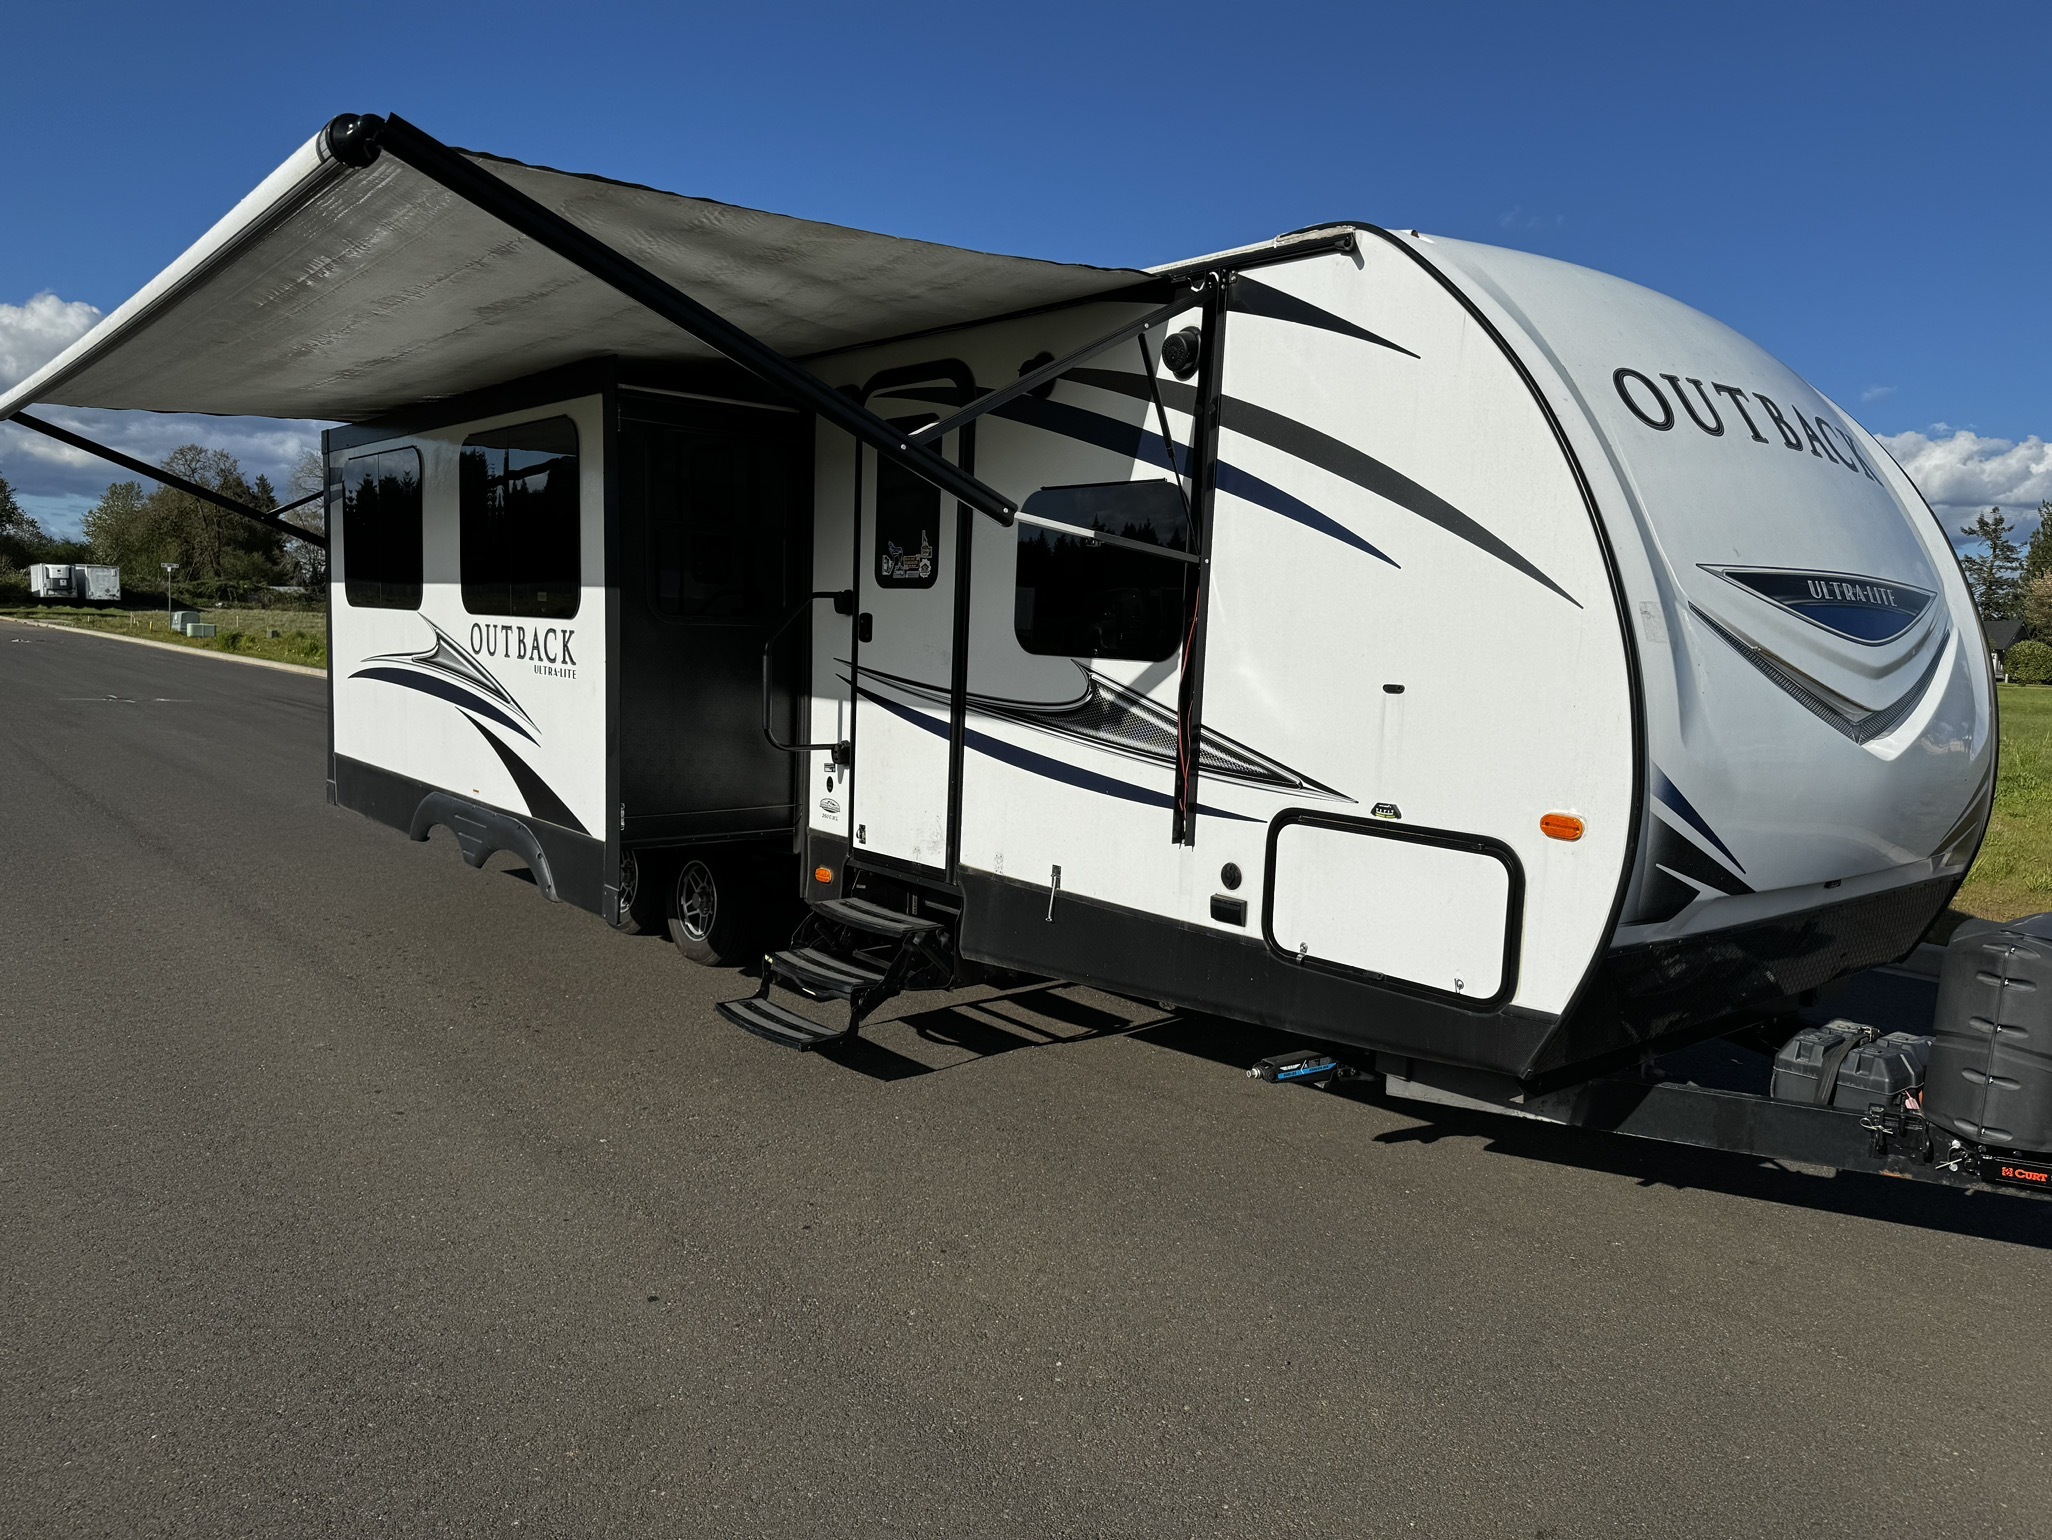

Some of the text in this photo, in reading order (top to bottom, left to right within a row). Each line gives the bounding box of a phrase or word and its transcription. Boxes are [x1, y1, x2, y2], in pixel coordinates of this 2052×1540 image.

[1612, 367, 1885, 488] OUTBACK
[1807, 580, 1897, 606] ULTRA-LITE
[470, 622, 577, 665] OUTBACK
[534, 665, 577, 679] ULTRA-LITE
[2014, 1169, 2048, 1182] CURT
